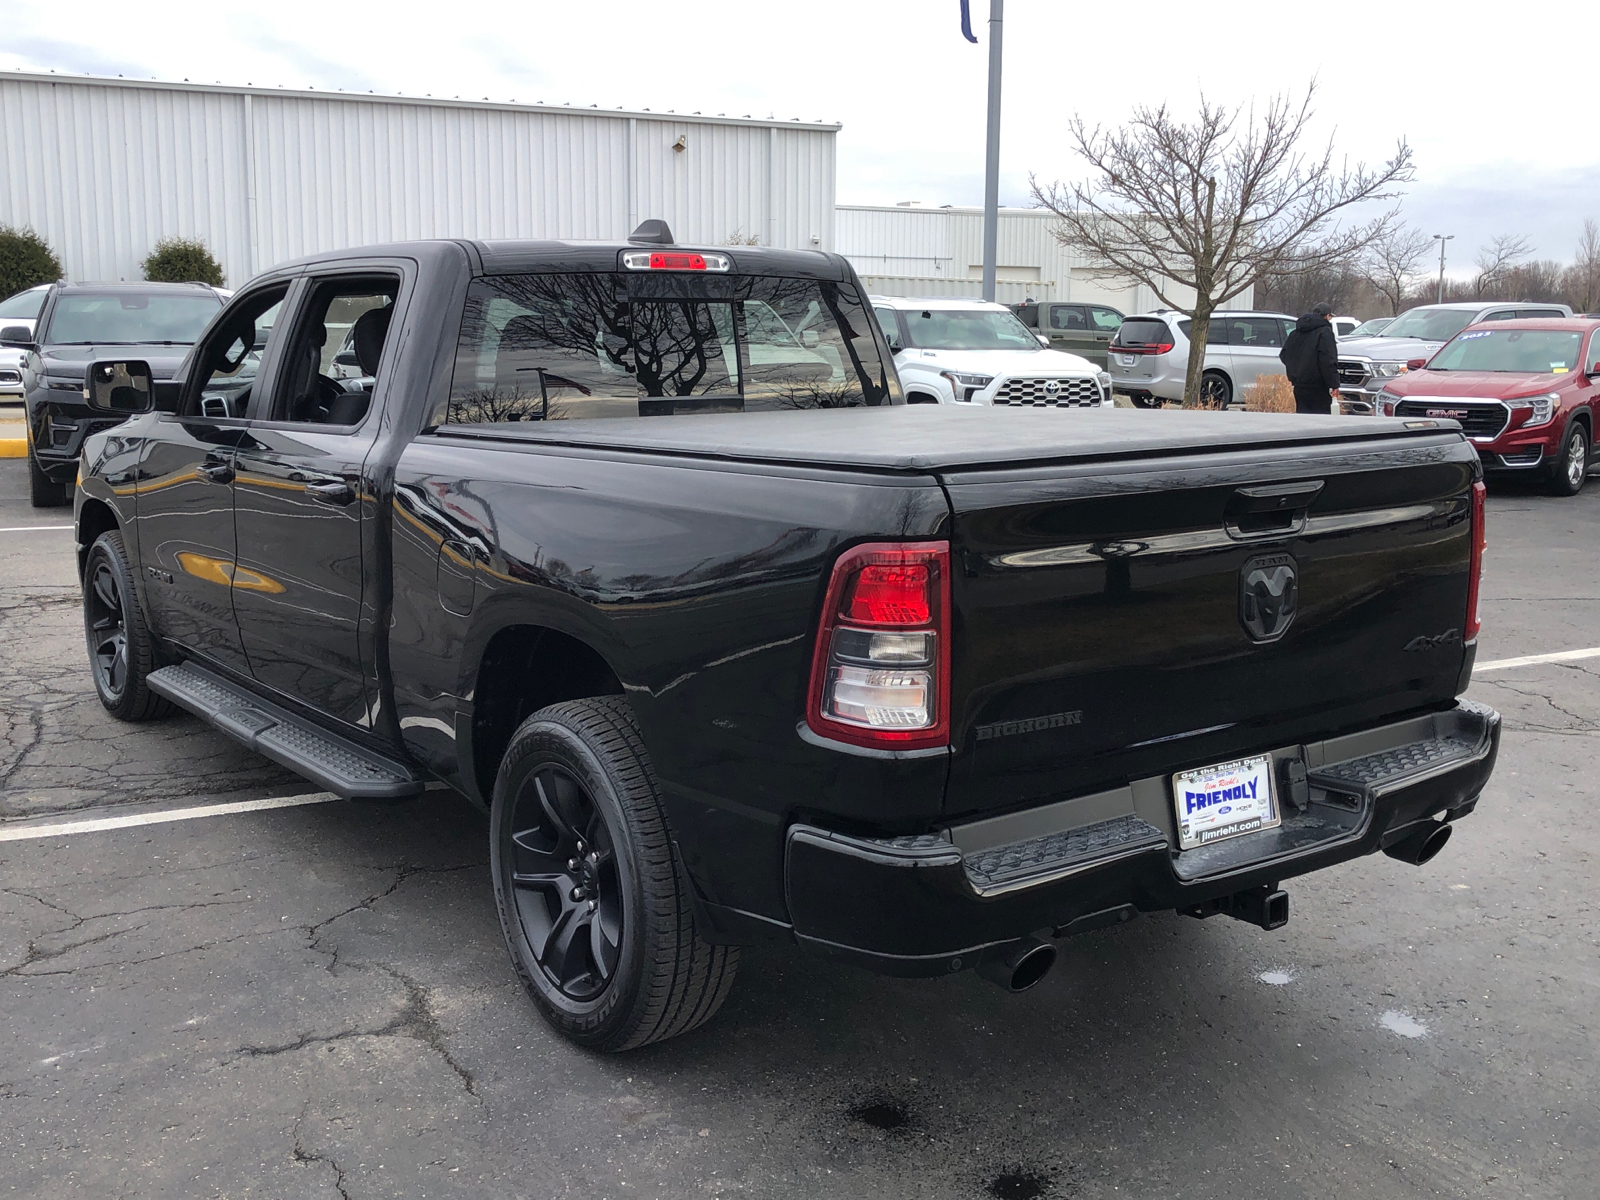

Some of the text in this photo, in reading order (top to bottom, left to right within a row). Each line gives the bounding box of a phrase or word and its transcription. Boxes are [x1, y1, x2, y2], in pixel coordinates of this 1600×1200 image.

[1425, 409, 1468, 419] GMC
[1255, 556, 1289, 567] RAM
[148, 566, 174, 584] RAM
[1181, 771, 1198, 780] Get
[1201, 767, 1216, 775] the
[1218, 762, 1241, 772] Riehl
[1244, 757, 1264, 766] Deal
[1204, 777, 1240, 793] Jim Riehl's
[1185, 775, 1258, 815] FRIENDLY
[1202, 821, 1260, 842] jimriehl.com
